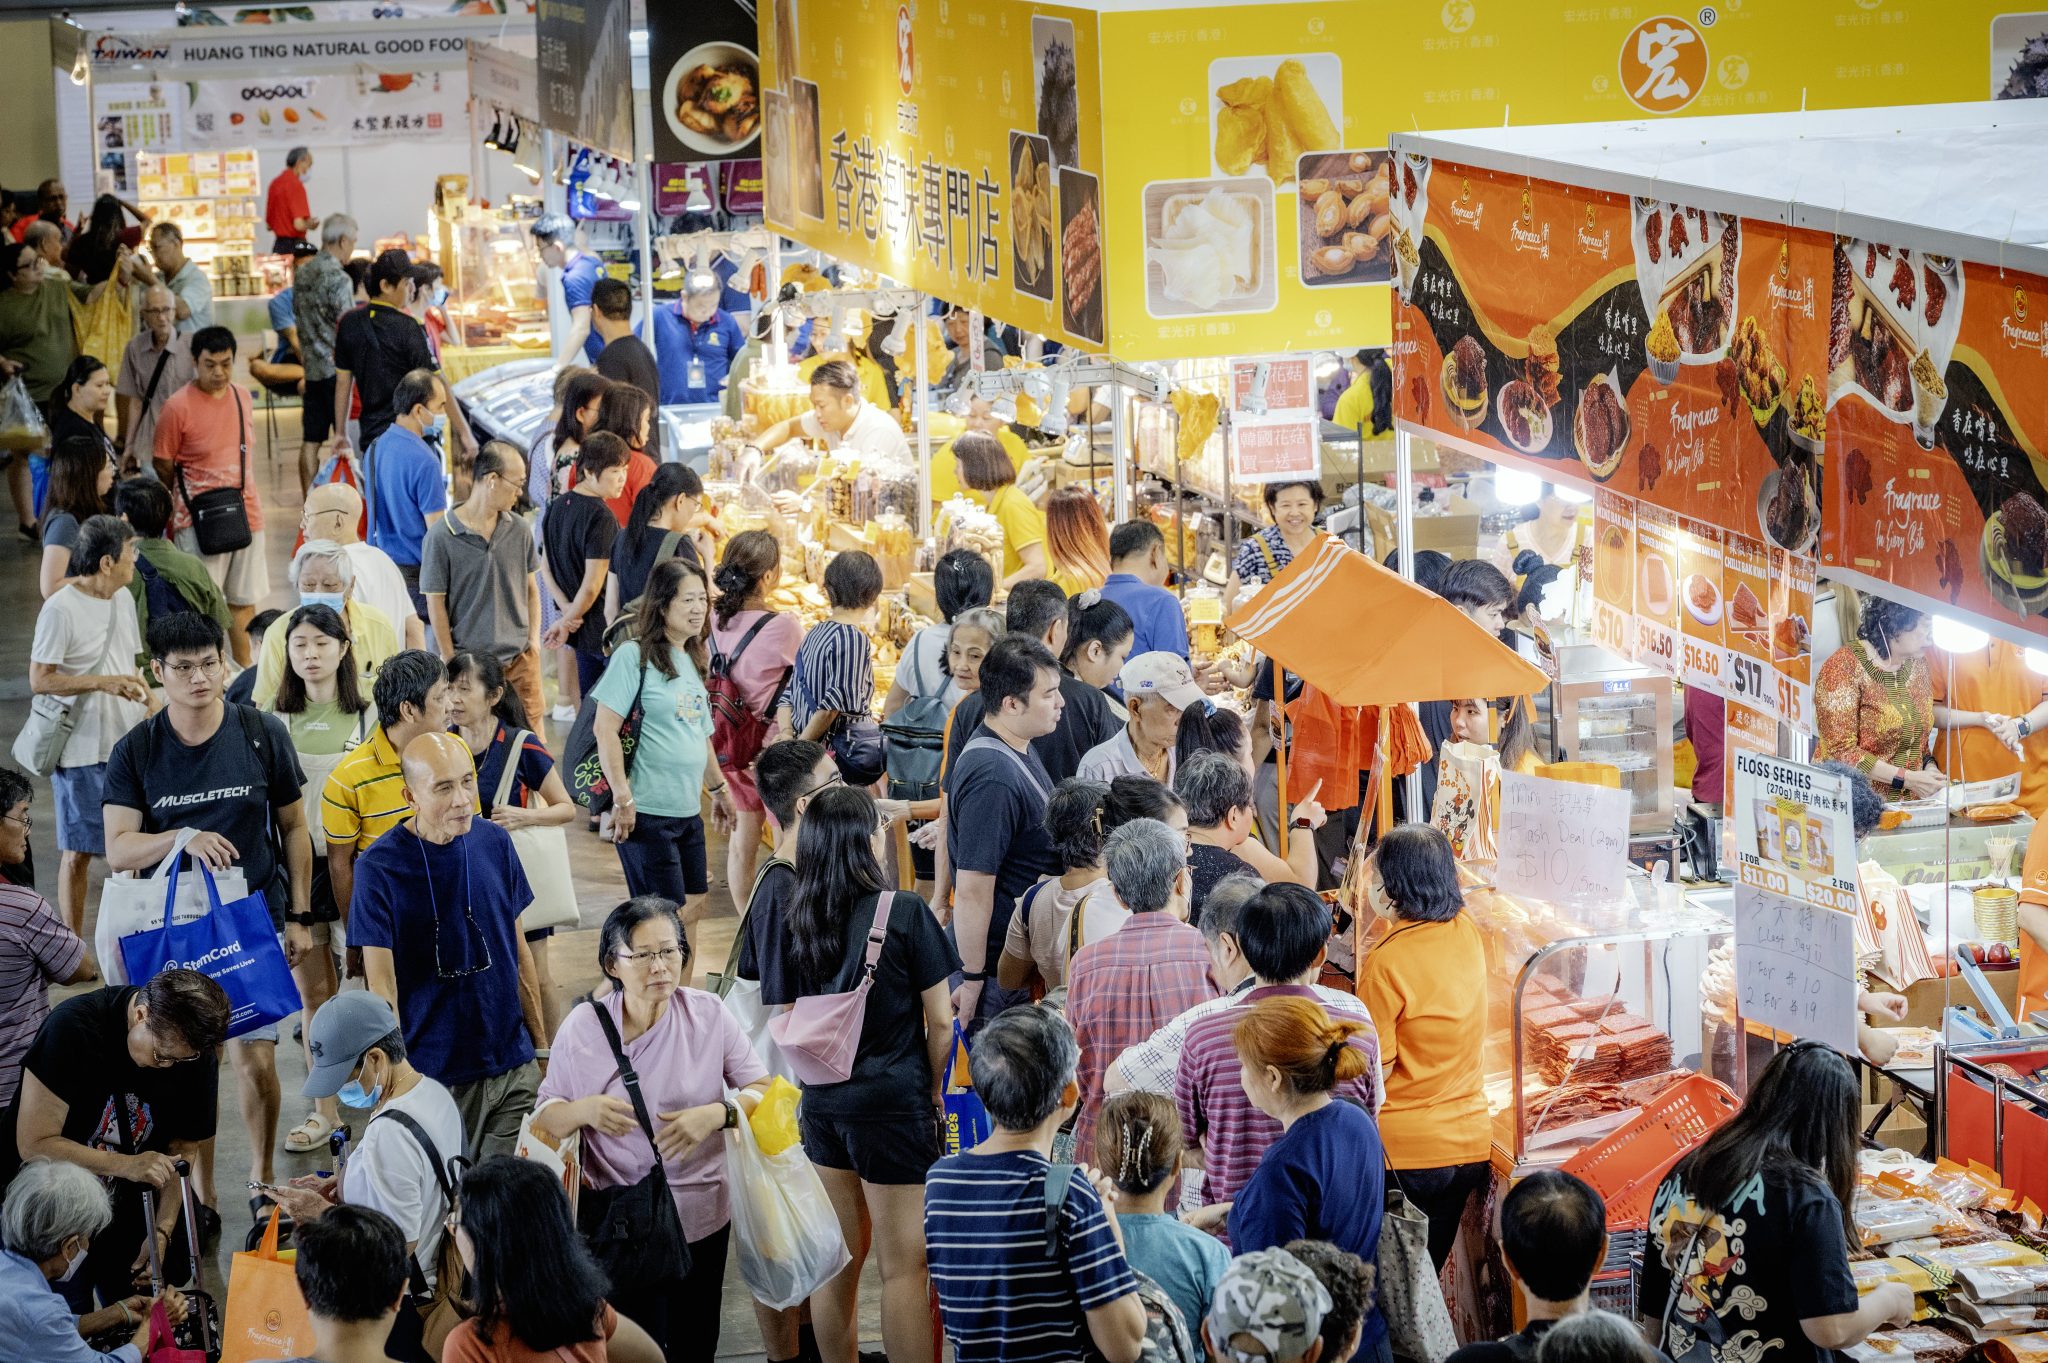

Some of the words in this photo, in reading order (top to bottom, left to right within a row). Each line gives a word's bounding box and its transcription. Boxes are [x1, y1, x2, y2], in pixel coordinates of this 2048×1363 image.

[91, 47, 169, 61] TAIWAN
[183, 45, 244, 61] HUANG
[249, 43, 286, 59] TING
[292, 41, 370, 57] NATURAL
[375, 39, 425, 54] GOOD
[429, 37, 468, 51] FOO
[2000, 315, 2041, 350] Fragrance
[1669, 400, 1720, 449] Fragrance
[1883, 476, 1942, 529] Fragrance
[1741, 561, 1753, 576] BAK
[1752, 565, 1767, 581] KWA
[1598, 606, 1624, 650] $10
[1639, 624, 1673, 660] $16.50
[1683, 644, 1719, 677] $16.50
[1734, 653, 1762, 698] $17
[1777, 672, 1801, 722] $15
[1737, 755, 1770, 779] FLOSS
[1773, 765, 1812, 791] SERIES
[152, 785, 250, 809] MUSCLETECH
[1511, 782, 1541, 807] Mini
[1766, 782, 1793, 801] (270g)
[1509, 811, 1550, 845] Flash
[1557, 820, 1585, 845] Deal
[1590, 826, 1626, 855] (2pm)
[1515, 847, 1570, 886] $10
[1745, 853, 1760, 866] FOR
[1743, 864, 1787, 893] $11.00
[1832, 878, 1838, 888] 2
[1839, 880, 1855, 893] FOR
[1807, 881, 1856, 913] $20.00
[182, 940, 242, 973] StemCord
[221, 963, 241, 975] Saves
[240, 958, 256, 968] Lives
[1758, 960, 1776, 980] For
[1745, 985, 1755, 1005] 2
[1763, 992, 1783, 1011] For
[945, 1112, 960, 1154] ulie's
[247, 1327, 283, 1345] Fragrance
